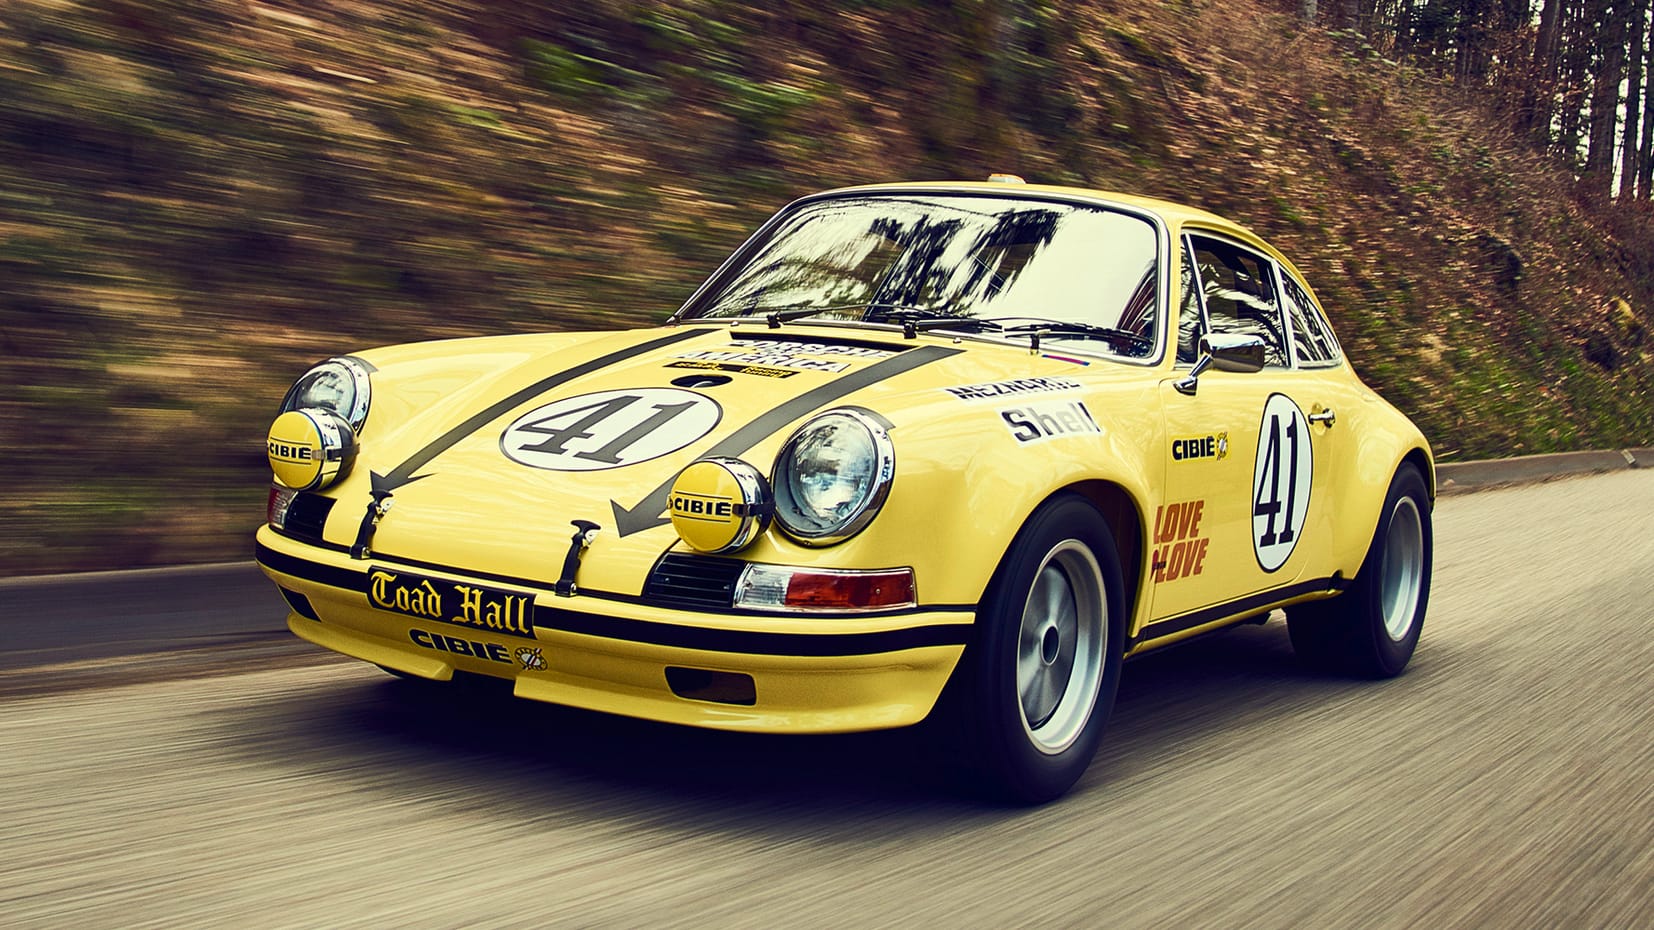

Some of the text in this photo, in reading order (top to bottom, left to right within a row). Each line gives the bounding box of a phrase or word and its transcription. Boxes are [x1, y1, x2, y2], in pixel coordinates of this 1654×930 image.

[673, 351, 851, 373] AMERICA
[515, 395, 699, 464] 41
[1001, 402, 1101, 442] Shell
[1253, 411, 1299, 548] 41
[1153, 500, 1204, 545] LOVE
[1154, 538, 1209, 584] LOVE
[370, 571, 529, 634] Toad Hall
